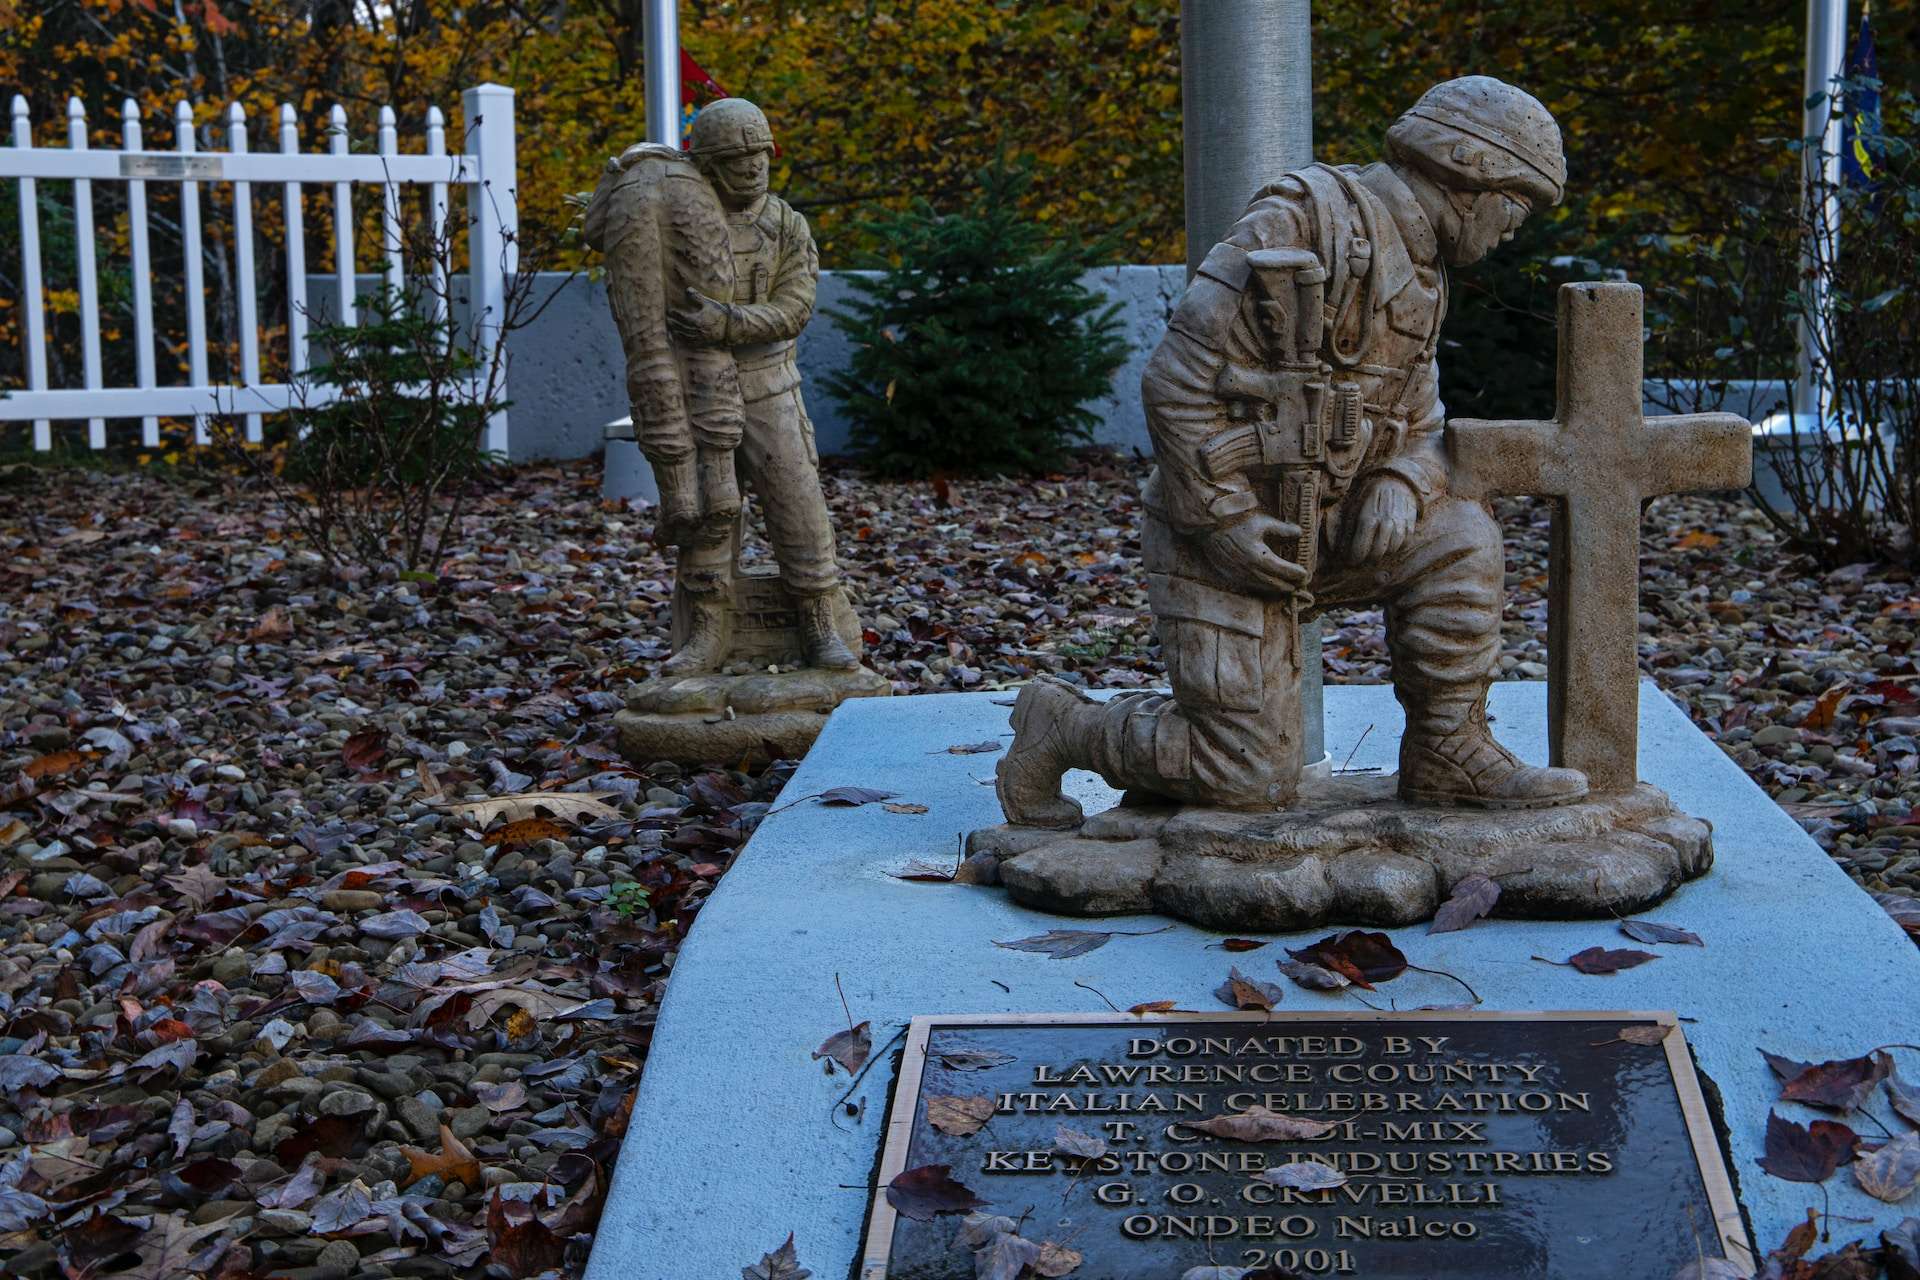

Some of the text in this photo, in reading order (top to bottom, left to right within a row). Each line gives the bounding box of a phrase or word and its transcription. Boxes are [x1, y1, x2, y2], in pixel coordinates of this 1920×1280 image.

[1129, 1037, 1449, 1055] DONATED BY
[1035, 1064, 1545, 1083] LAWRENCE COUNTY
[999, 1092, 1591, 1112] ITALIAN CELEBRATION
[1105, 1121, 1143, 1141] T.
[1288, 1151, 1613, 1172] INDUSTRIES
[1097, 1183, 1502, 1204] G. O. CRIVELLI
[1123, 1215, 1477, 1237] ONDEO Nalco
[1244, 1248, 1353, 1271] 2001
